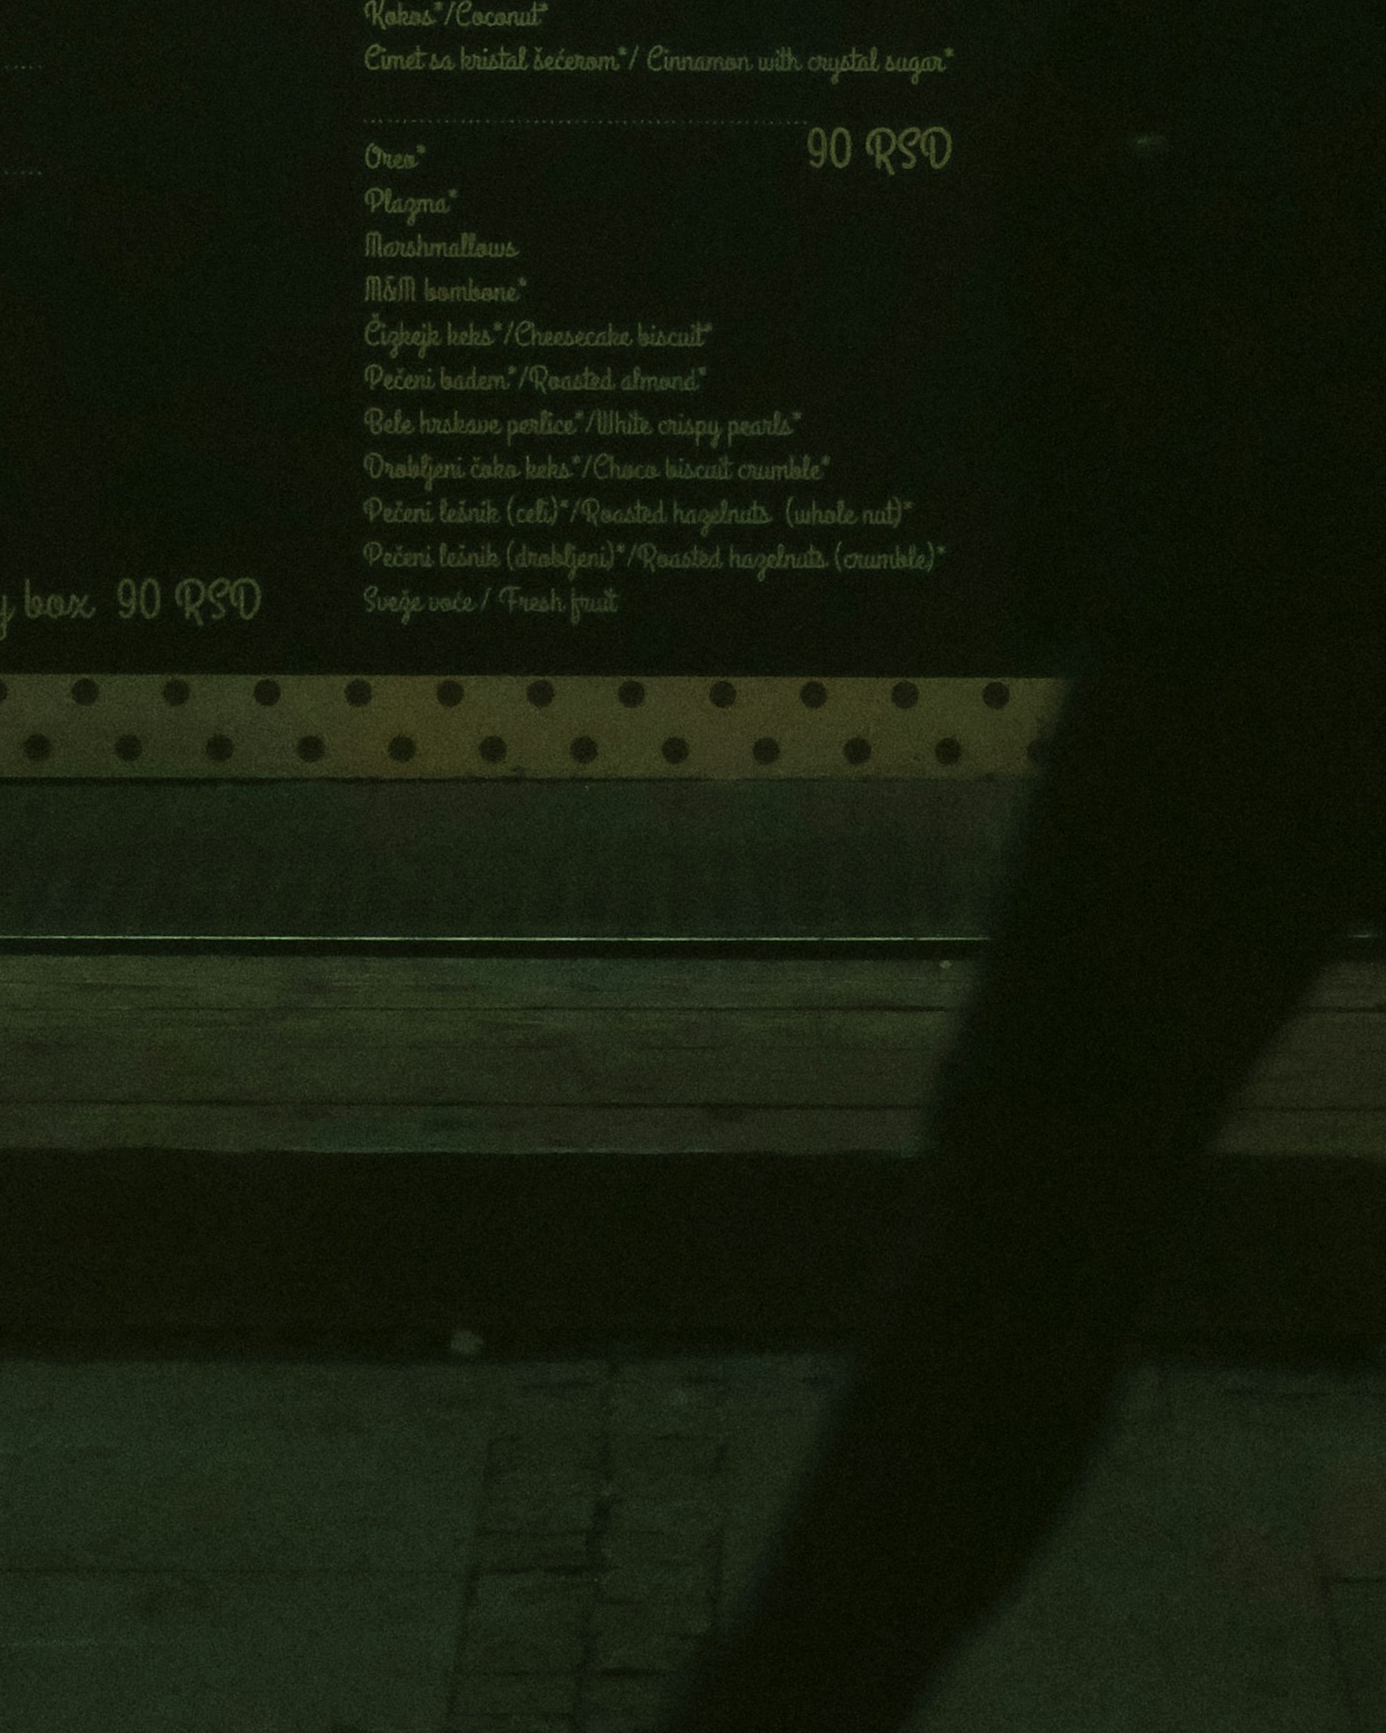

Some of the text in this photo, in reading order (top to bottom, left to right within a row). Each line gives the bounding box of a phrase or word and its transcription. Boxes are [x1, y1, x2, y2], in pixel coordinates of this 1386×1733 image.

[363, 42, 426, 73] Cimet
[429, 51, 457, 72] sa
[460, 43, 528, 73] kristal
[646, 43, 754, 73] Cinnamon
[757, 45, 803, 73] with
[807, 44, 881, 84] crystal
[807, 127, 852, 169] 90
[865, 126, 953, 176] RSD
[363, 230, 521, 259] Marshmallows
[363, 273, 417, 303] M&M
[363, 363, 436, 392] Pečeni
[419, 408, 502, 436] hrskave
[657, 412, 723, 449] crispy
[363, 451, 467, 492] Drobljeni
[664, 455, 734, 481] biscuit
[363, 496, 436, 524] Pečeni
[439, 496, 501, 524] lešnik
[672, 498, 774, 539] hazelnuts
[784, 495, 859, 529] (whole
[363, 540, 436, 569] Pečeni
[439, 541, 501, 569] lešnik
[728, 542, 830, 583] hazelnuts
[23, 577, 97, 621] box
[115, 577, 162, 621] 90
[173, 576, 262, 628] RSD
[428, 588, 478, 613] voće
[498, 585, 569, 613] Fresh
[569, 586, 619, 626] fruit
